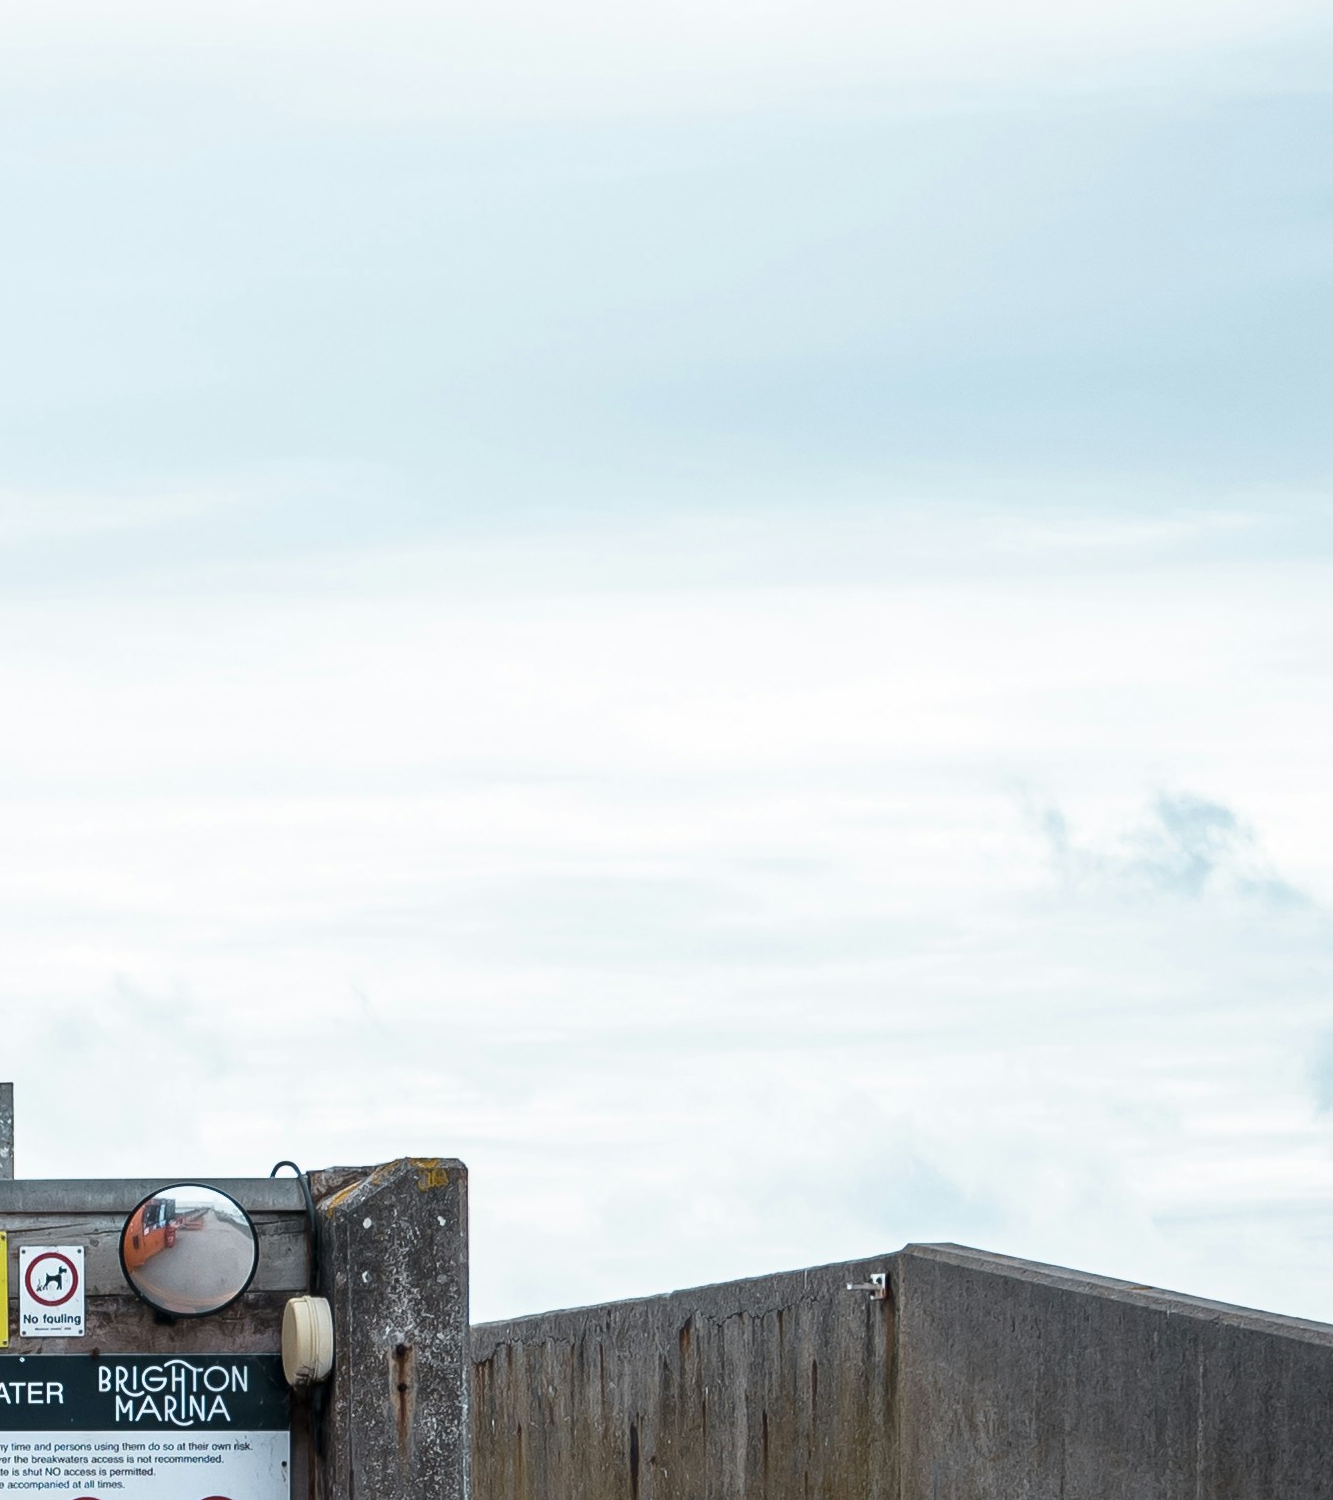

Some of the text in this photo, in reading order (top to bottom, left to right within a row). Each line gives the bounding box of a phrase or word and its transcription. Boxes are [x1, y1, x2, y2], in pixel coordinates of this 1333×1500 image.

[23, 1313, 82, 1326] No fouling
[98, 1359, 248, 1398] BRIGHTON
[115, 1396, 232, 1426] MARINA
[10, 1443, 32, 1452] time
[33, 1442, 52, 1452] and
[53, 1443, 93, 1453] persons
[93, 1443, 120, 1454] using
[121, 1442, 146, 1451] them
[147, 1442, 161, 1451] do
[162, 1443, 175, 1451] so
[176, 1442, 186, 1451] at
[188, 1441, 210, 1451] their
[211, 1443, 232, 1451] own
[233, 1442, 254, 1452] risk.
[13, 1454, 29, 1464] the
[31, 1454, 89, 1464] breakwaters
[90, 1456, 125, 1464] access
[126, 1454, 135, 1464] is
[136, 1455, 152, 1464] not
[154, 1454, 225, 1464] recommended.
[11, 1469, 20, 1477] is
[22, 1467, 43, 1477] shut
[44, 1466, 62, 1477] NO
[63, 1468, 97, 1477] access
[98, 1468, 107, 1477] is
[109, 1467, 156, 1478] permitted.
[7, 1480, 70, 1491] accompanied
[72, 1480, 82, 1489] at
[83, 1479, 95, 1489] all
[97, 1479, 126, 1489] times.
